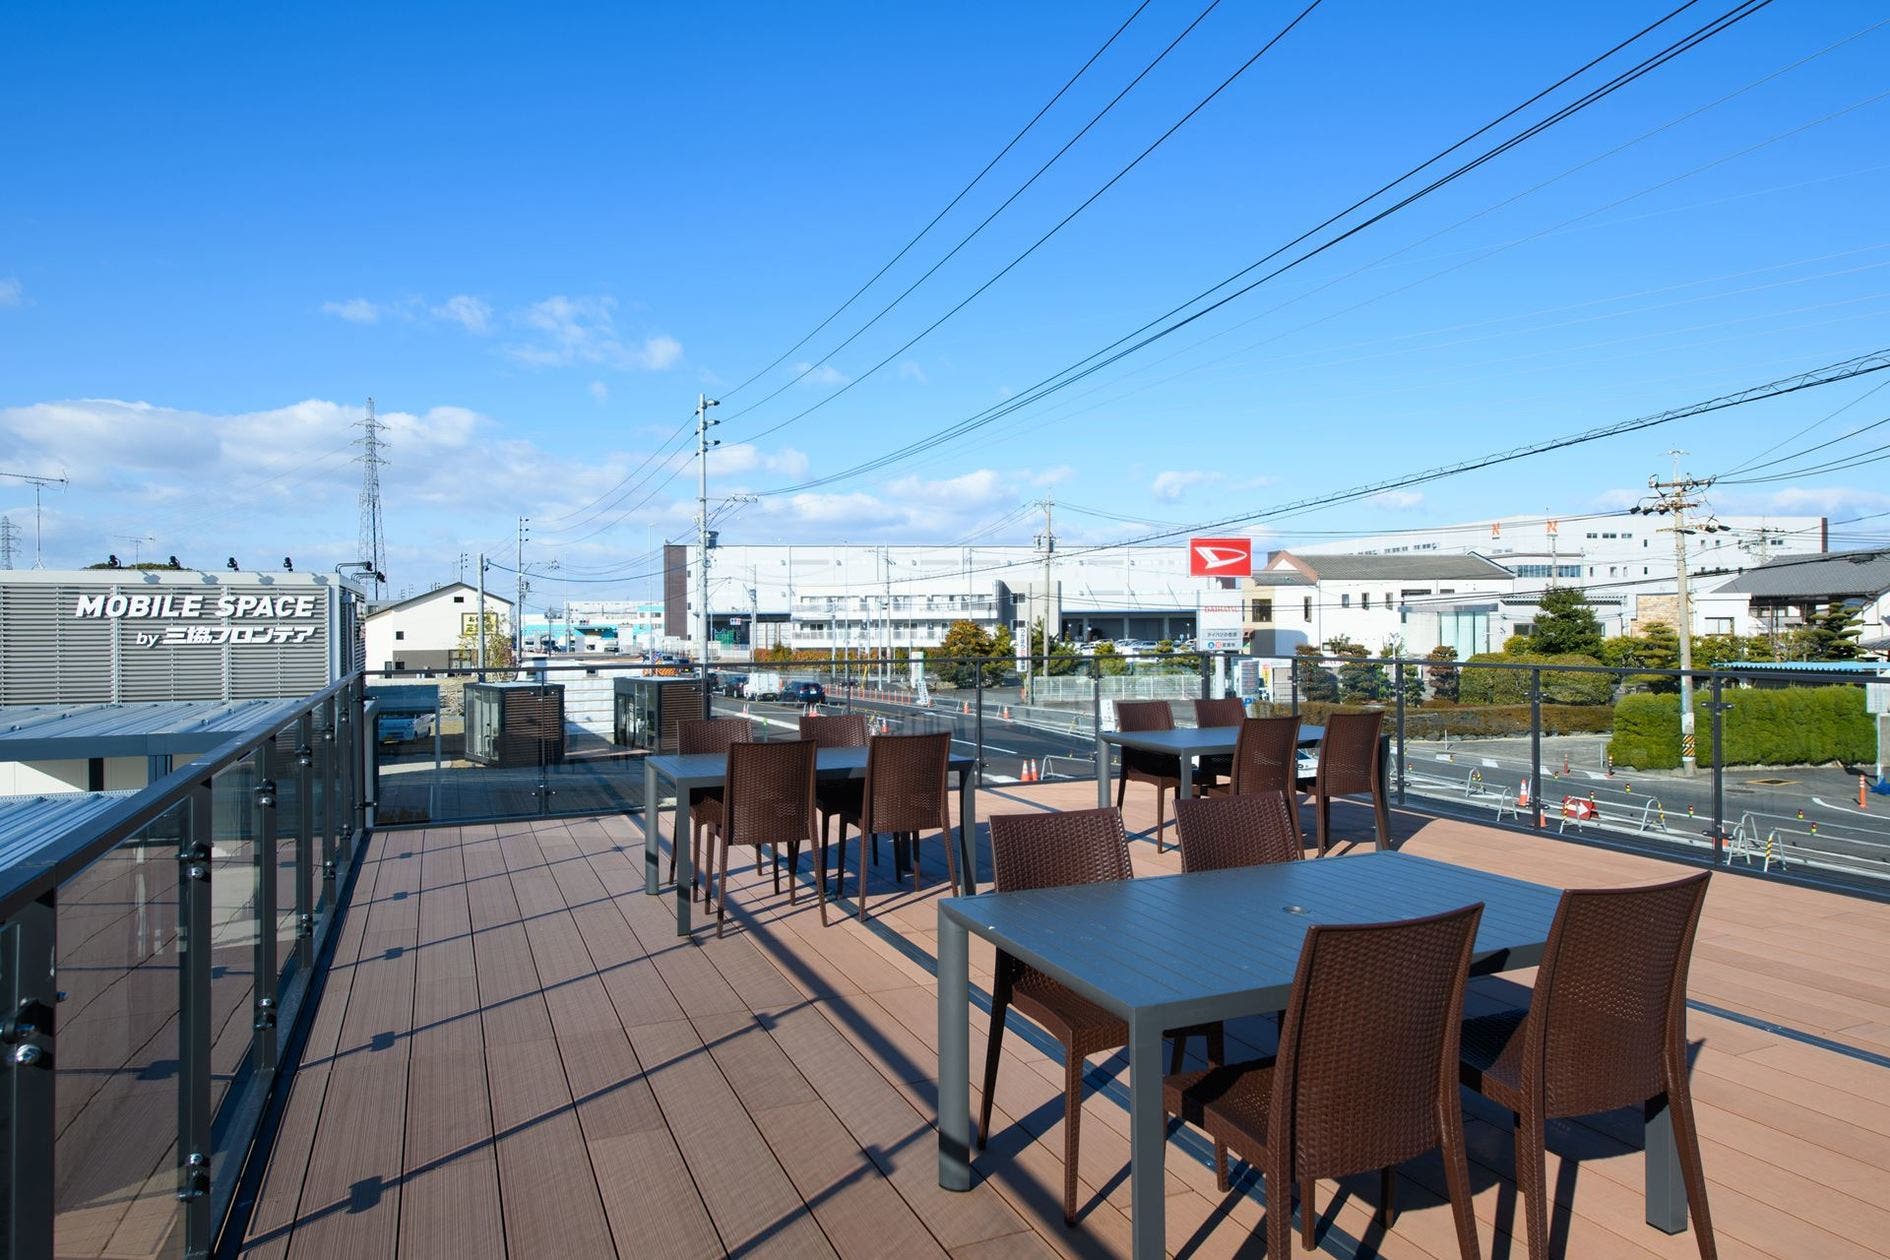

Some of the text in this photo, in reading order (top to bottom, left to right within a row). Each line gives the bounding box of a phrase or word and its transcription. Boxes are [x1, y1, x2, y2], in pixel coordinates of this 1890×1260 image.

[75, 594, 317, 618] MOBILE SPACE
[136, 625, 317, 648] by 三協フロンテア
